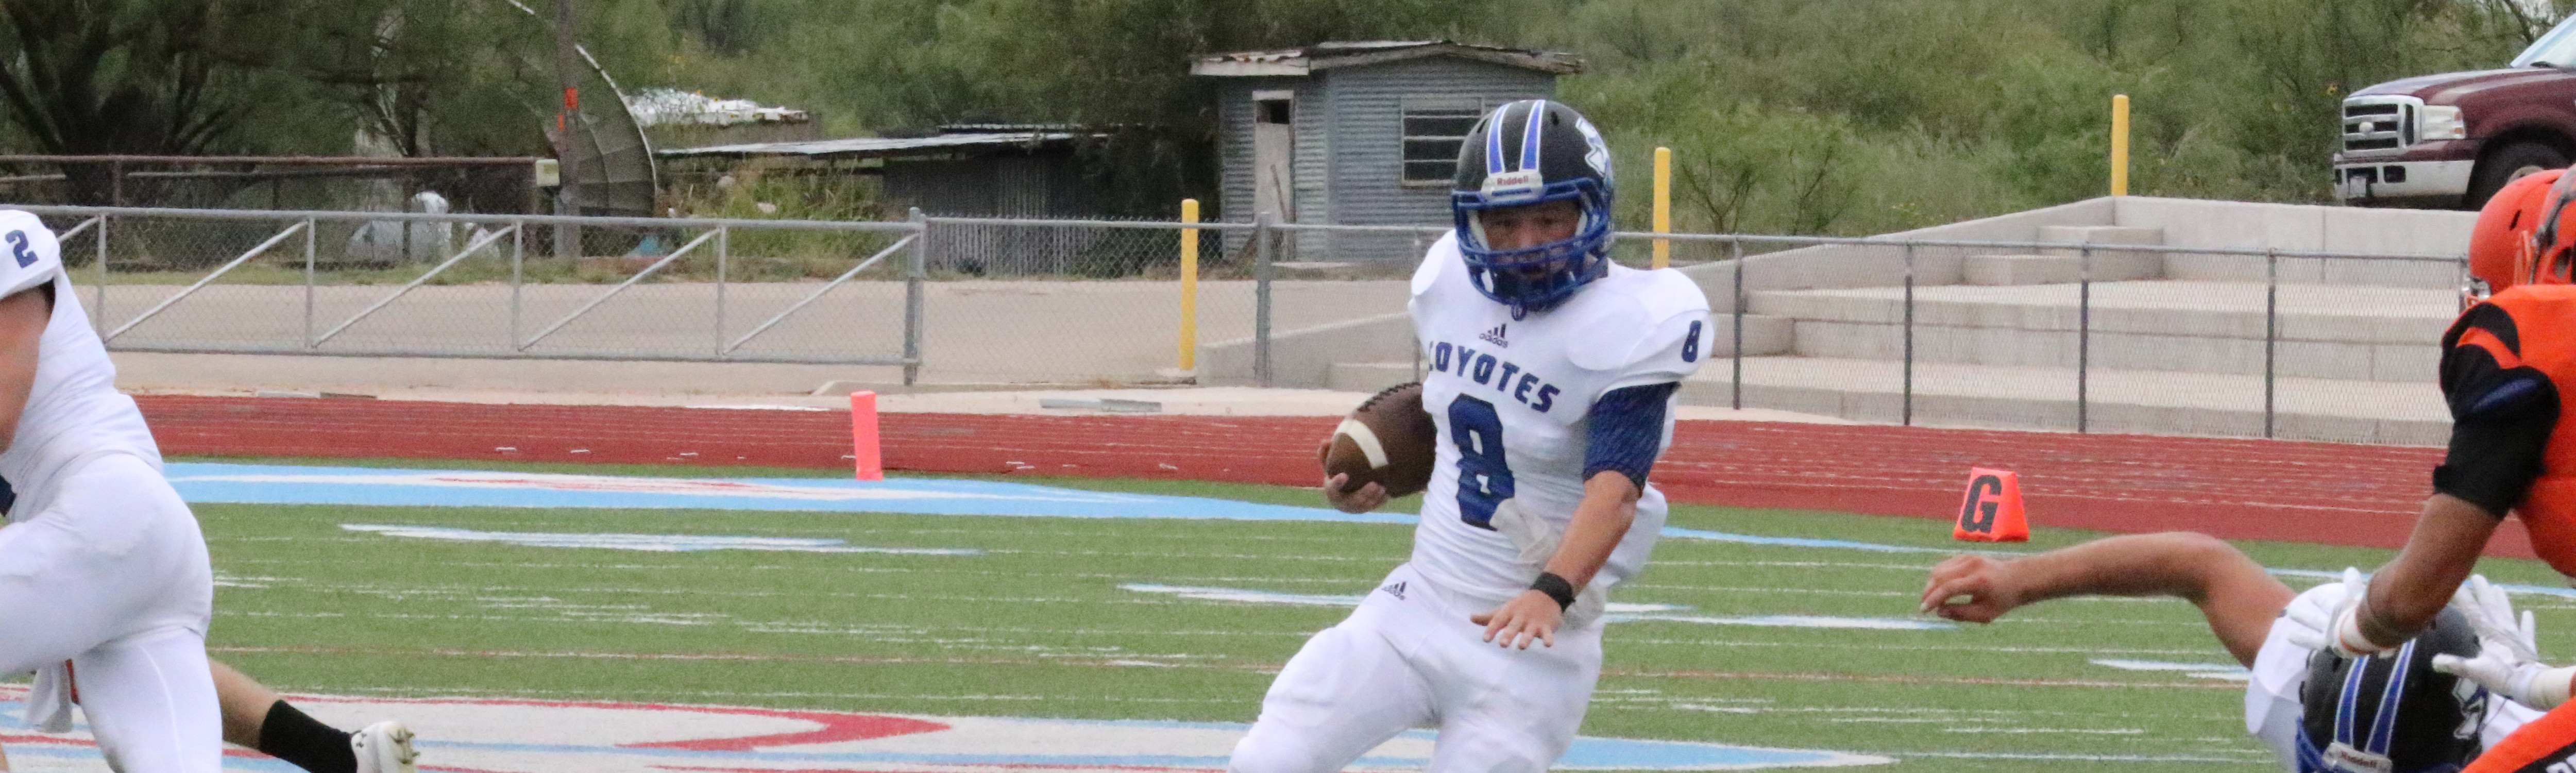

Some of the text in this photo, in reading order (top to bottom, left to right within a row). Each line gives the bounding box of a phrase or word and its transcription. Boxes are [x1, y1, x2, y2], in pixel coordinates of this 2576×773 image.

[1497, 176, 1529, 186] Riddell
[5, 230, 39, 268] 2
[1479, 333, 1508, 348] adidas
[1681, 320, 1702, 363] 8
[1447, 393, 1515, 532] 8
[1961, 475, 2003, 533] G
